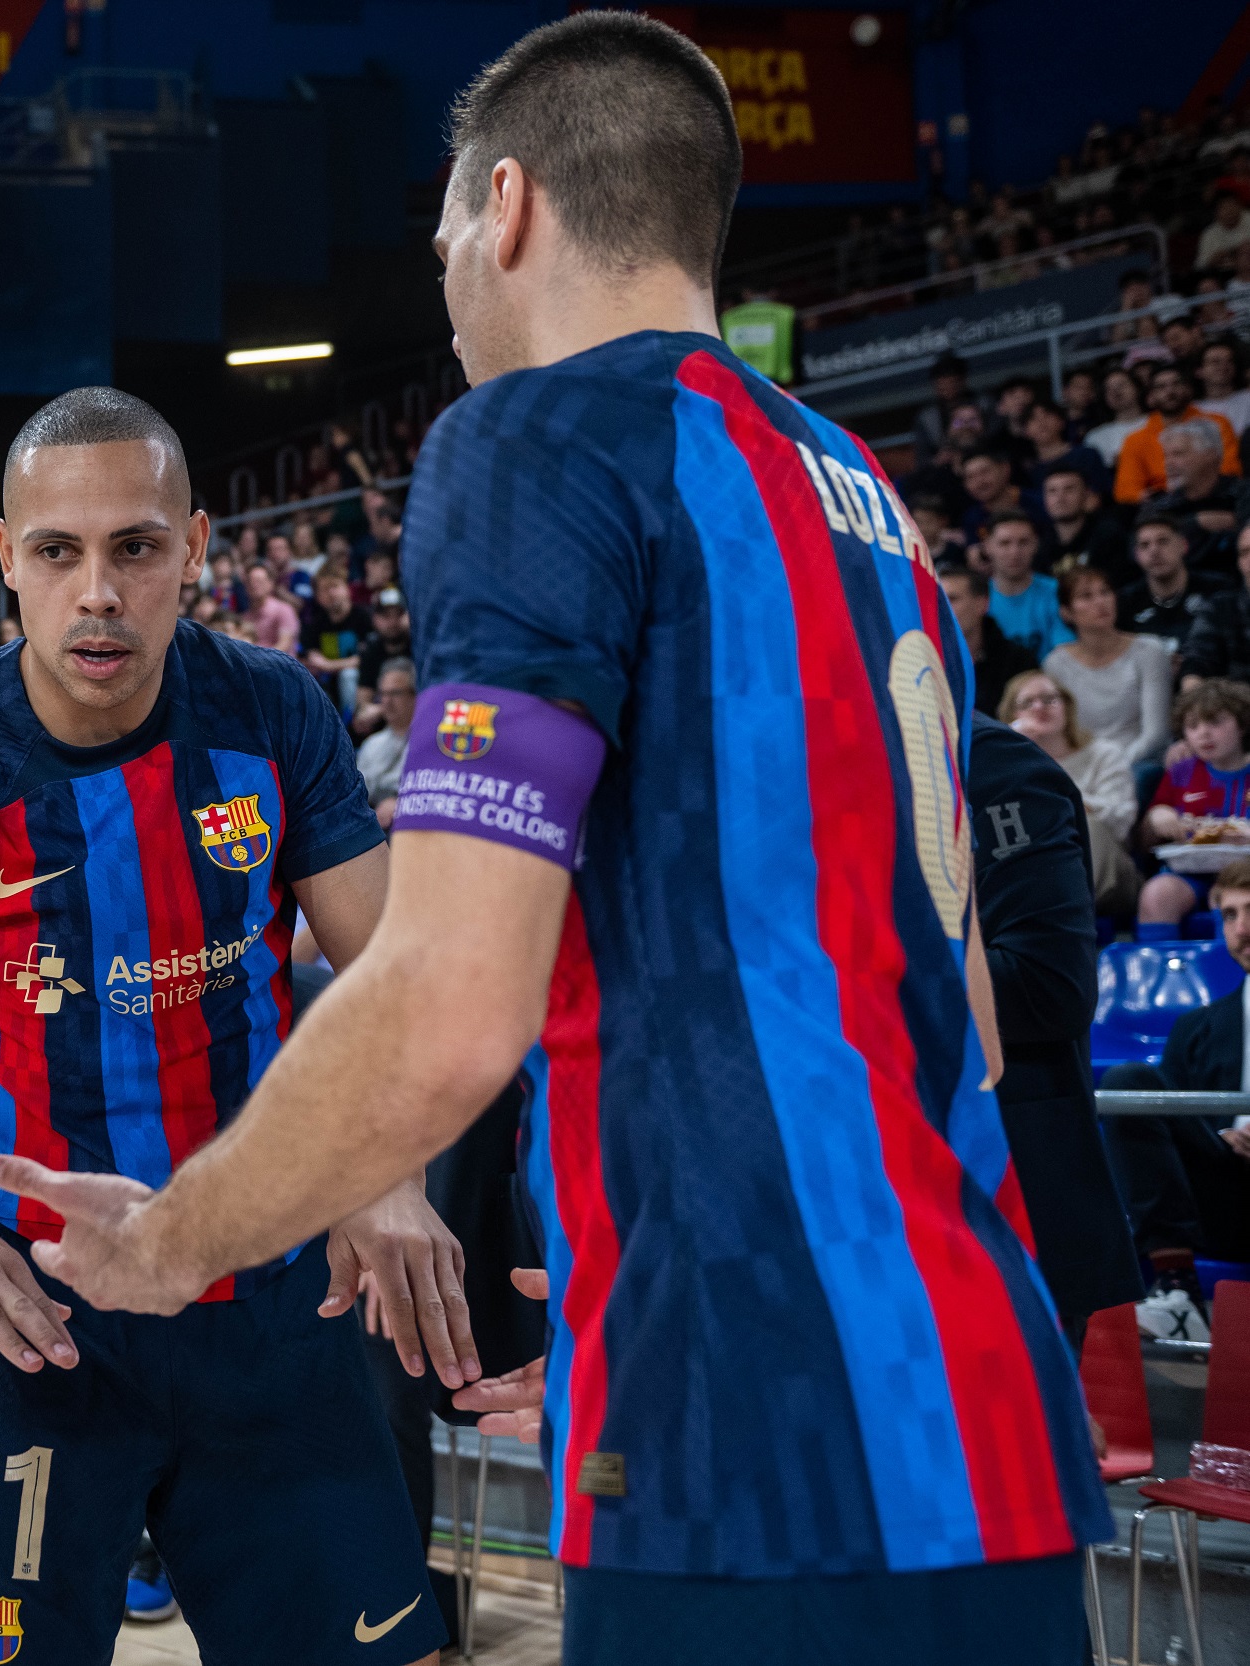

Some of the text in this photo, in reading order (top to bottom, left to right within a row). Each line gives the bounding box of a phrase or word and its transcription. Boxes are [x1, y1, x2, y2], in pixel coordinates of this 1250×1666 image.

[512, 781, 546, 814] ÉS
[220, 828, 248, 842] FCB
[479, 802, 568, 851] COLORS
[986, 801, 1031, 860] H
[108, 972, 235, 1016] Sanitària
